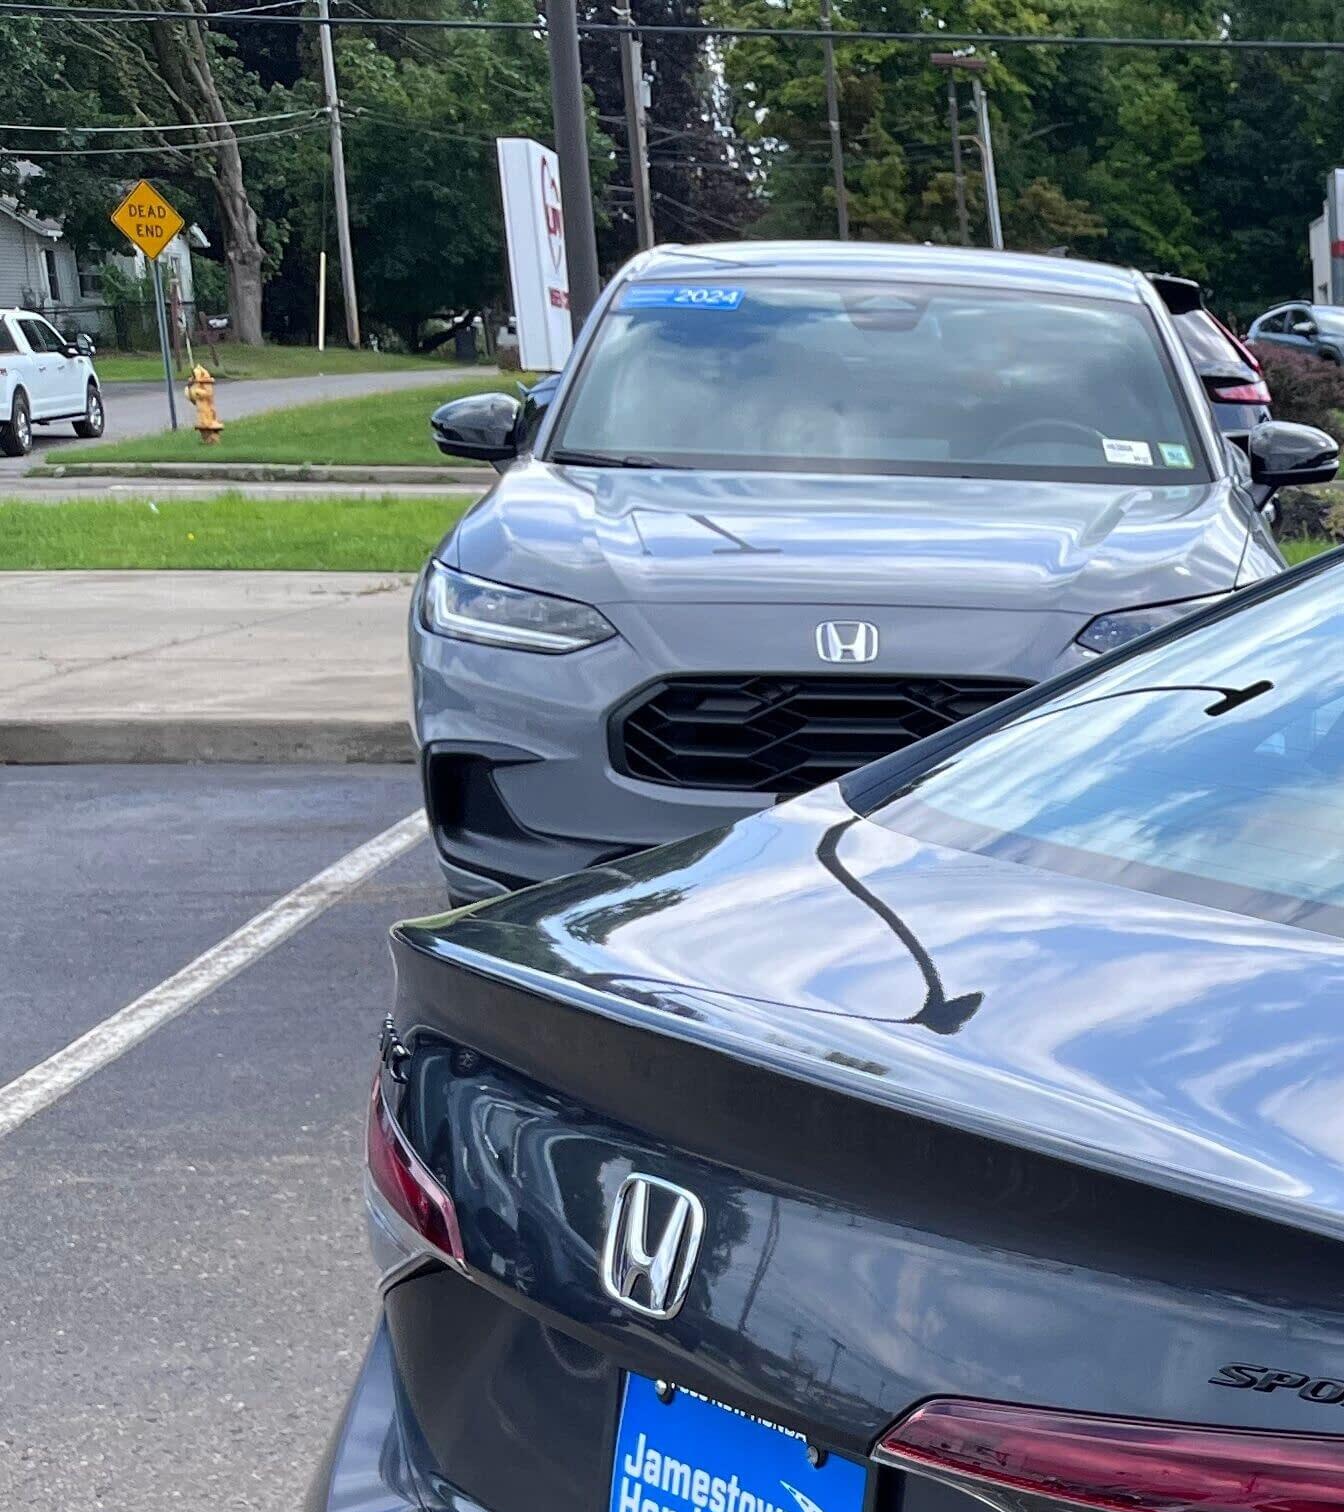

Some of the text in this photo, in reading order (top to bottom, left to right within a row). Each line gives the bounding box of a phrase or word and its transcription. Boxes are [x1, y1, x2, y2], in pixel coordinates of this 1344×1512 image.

[128, 204, 166, 218] DEAD
[136, 224, 163, 237] END
[674, 288, 738, 305] 2024
